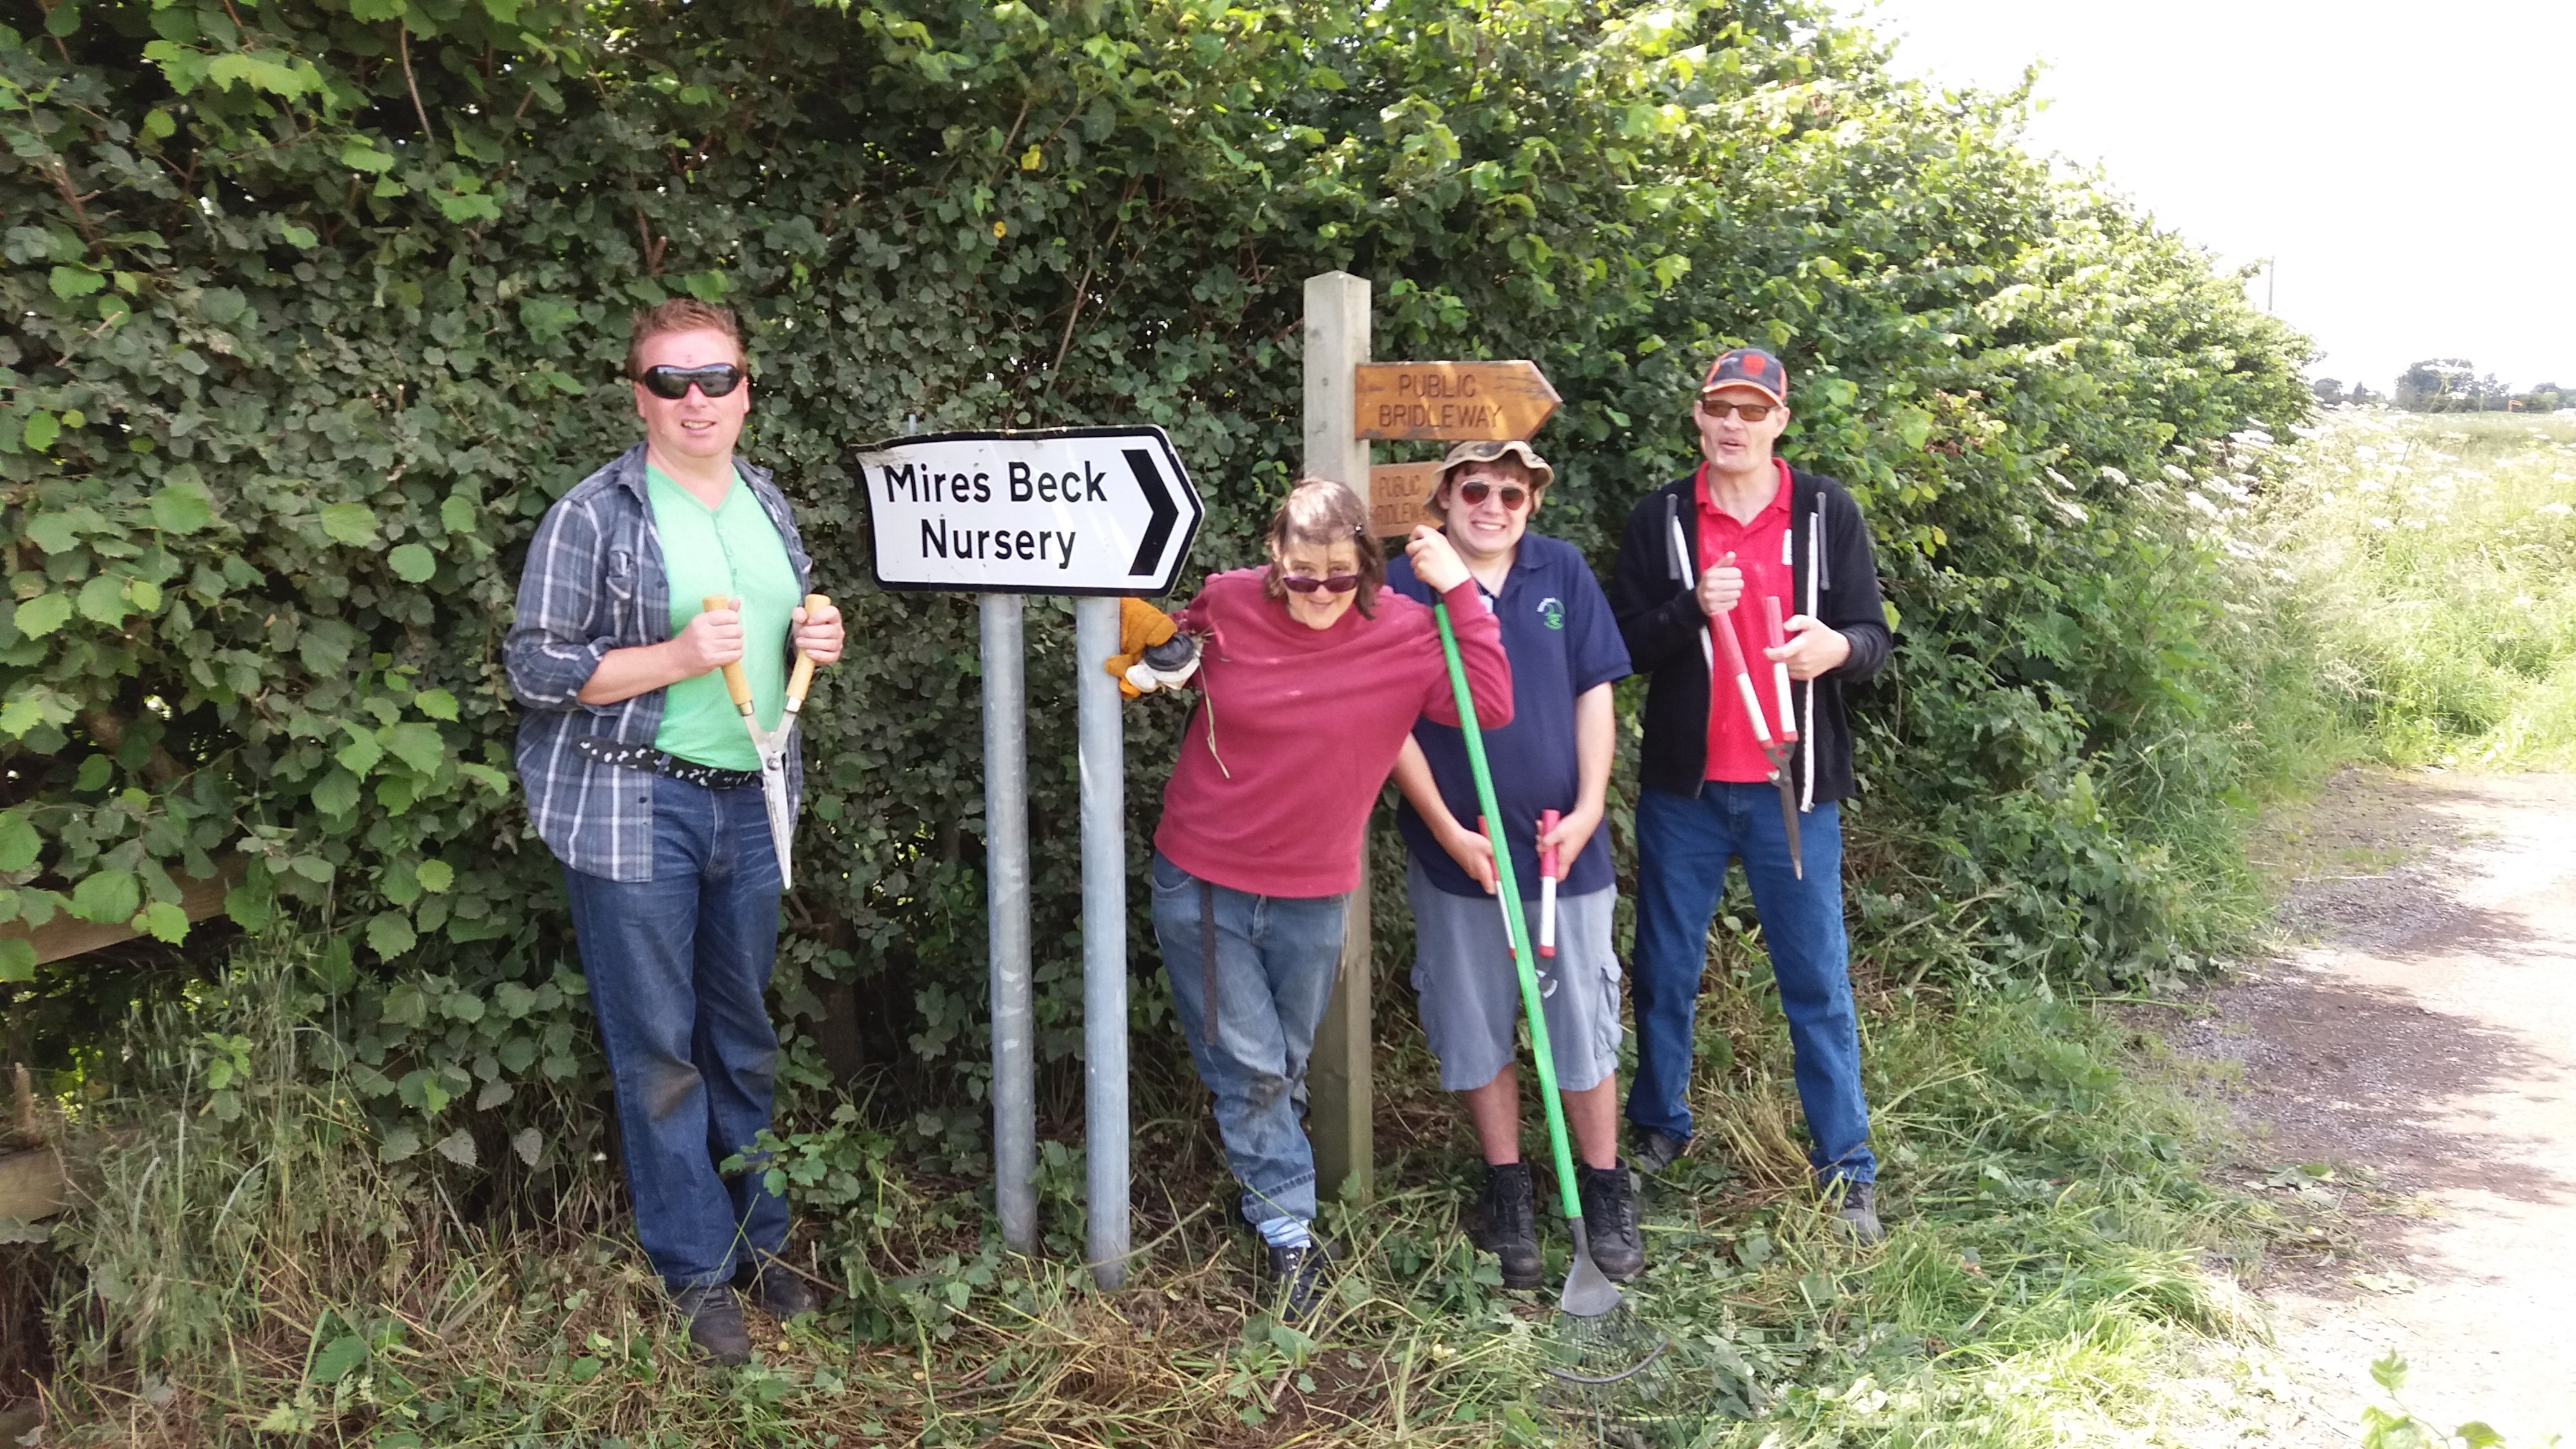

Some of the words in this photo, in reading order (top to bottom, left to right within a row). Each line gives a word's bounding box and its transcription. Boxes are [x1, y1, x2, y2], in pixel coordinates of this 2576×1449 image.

[1398, 374, 1476, 398] PUBLIC
[1378, 404, 1502, 427] BRIDLEWAY
[884, 462, 992, 503] Mires
[1008, 460, 1108, 502] Beck
[1378, 474, 1421, 499] PUBLIC
[920, 518, 1077, 570] Nursery
